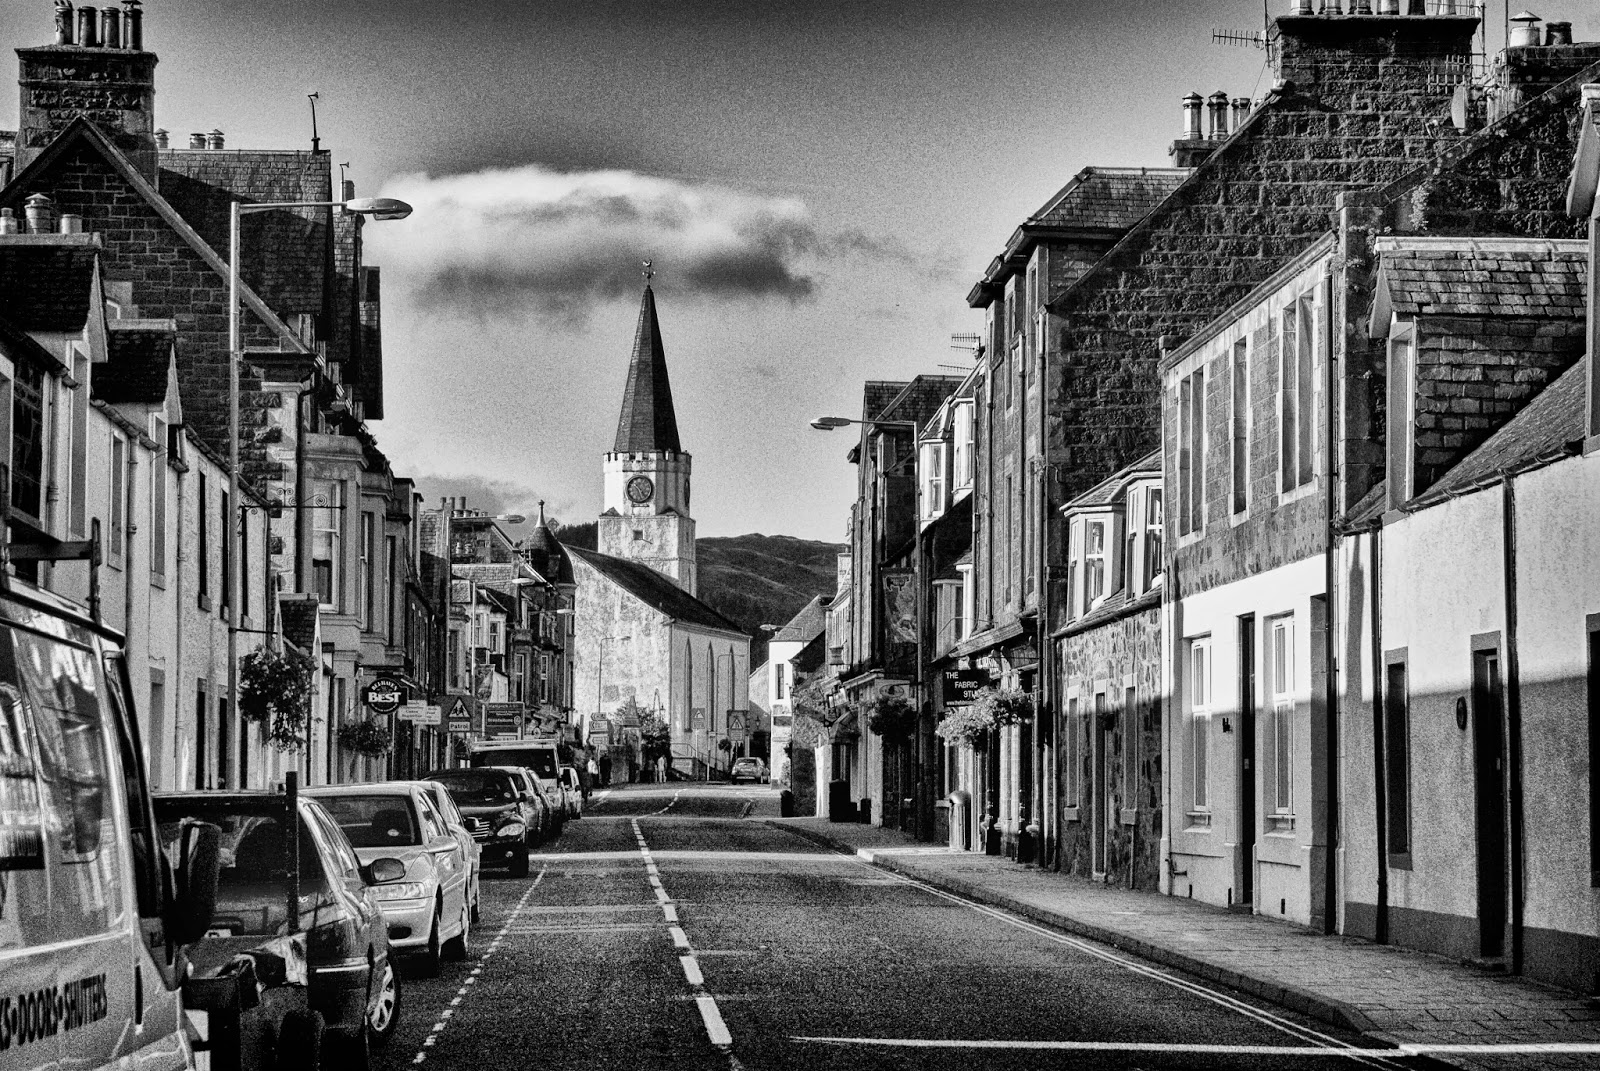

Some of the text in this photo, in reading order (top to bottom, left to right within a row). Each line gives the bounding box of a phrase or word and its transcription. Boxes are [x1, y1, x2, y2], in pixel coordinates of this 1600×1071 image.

[945, 671, 959, 679] THE
[954, 680, 979, 689] FABRIC
[368, 691, 402, 703] BEST
